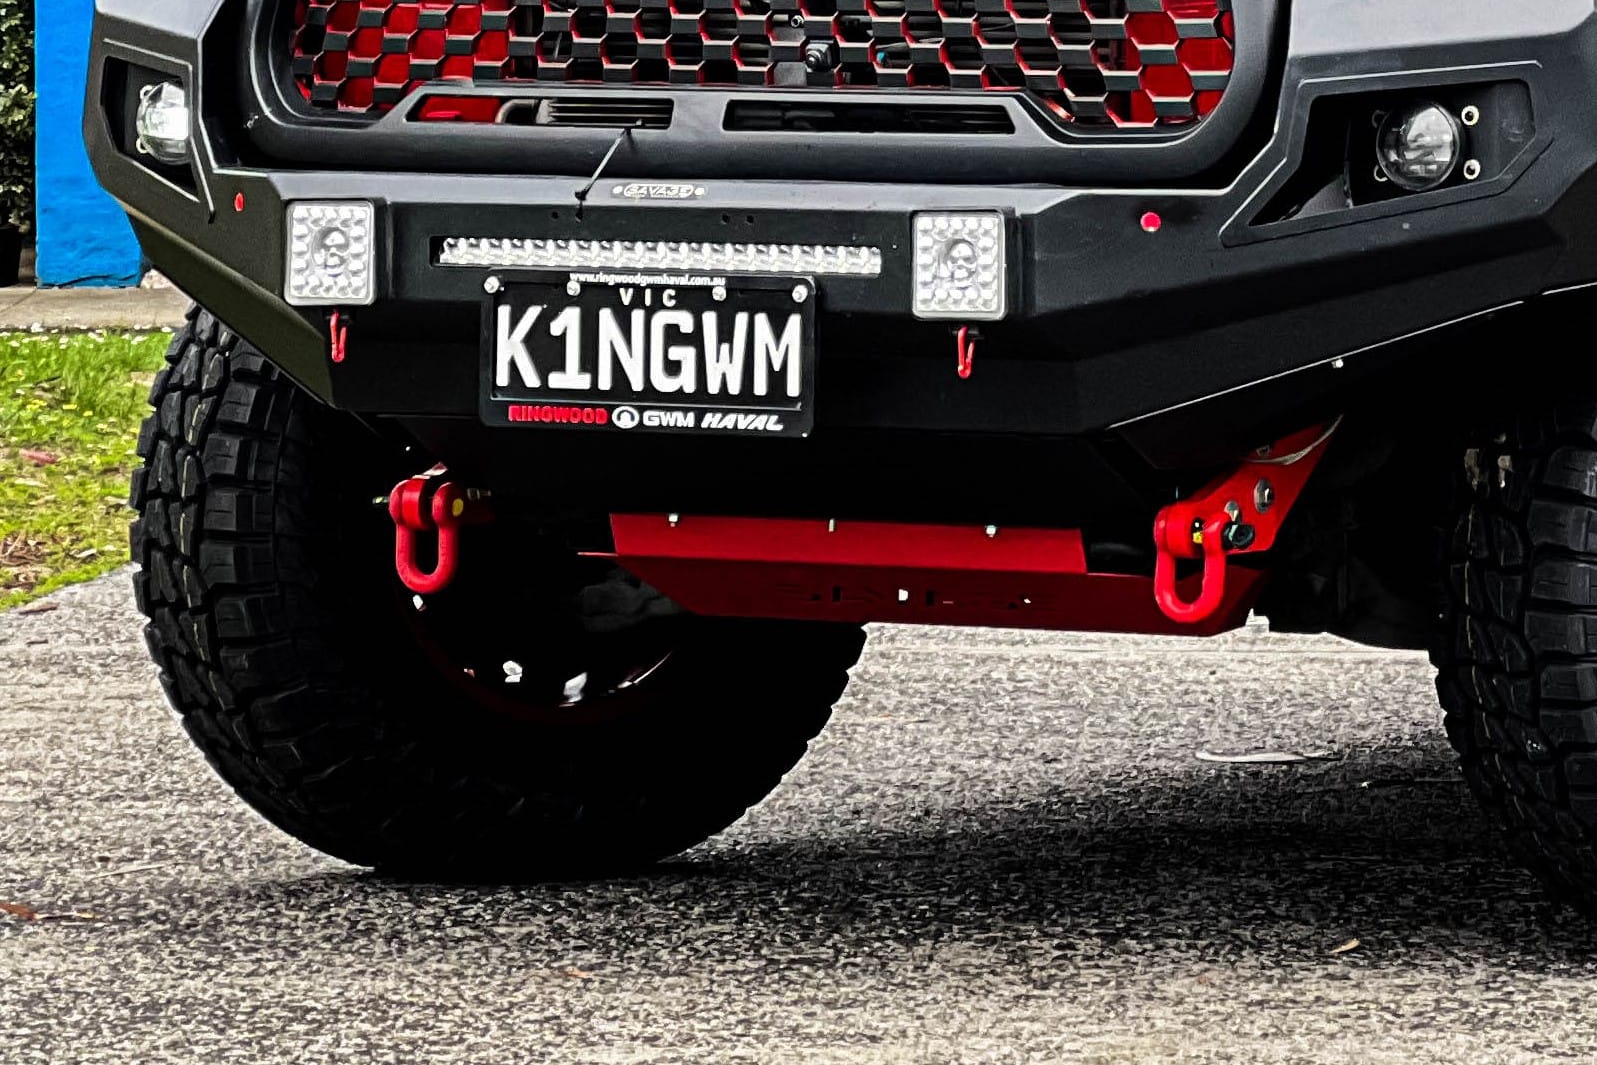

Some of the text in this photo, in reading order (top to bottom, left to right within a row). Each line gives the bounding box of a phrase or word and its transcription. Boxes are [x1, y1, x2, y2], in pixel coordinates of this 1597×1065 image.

[569, 271, 726, 287] www.ringwoodgwmhaval.com.au
[619, 288, 678, 307] VIC
[495, 303, 803, 398] K1NGWM
[507, 404, 784, 432] RINGWOOD GWM HAVAL
